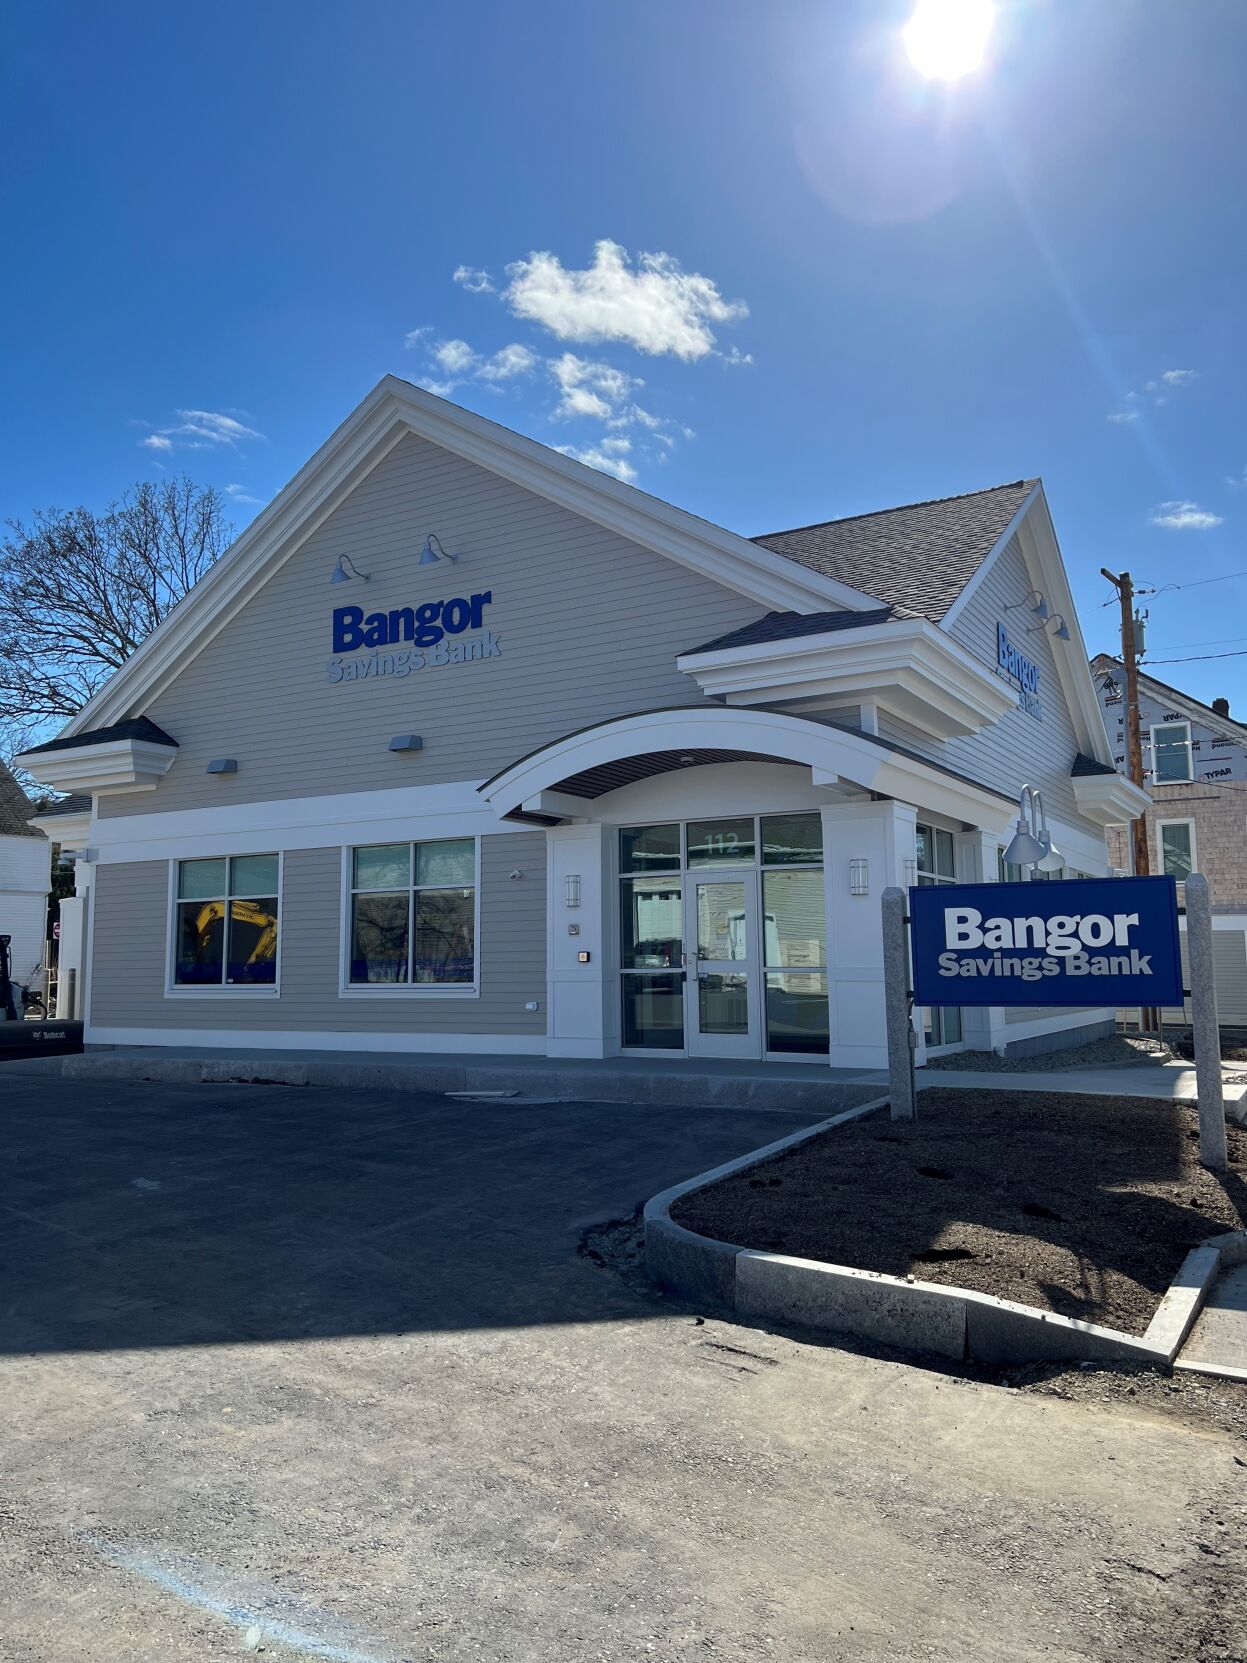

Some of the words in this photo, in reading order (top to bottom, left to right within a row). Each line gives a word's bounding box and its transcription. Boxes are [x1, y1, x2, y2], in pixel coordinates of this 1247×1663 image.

[332, 590, 492, 653] Bangor
[326, 648, 426, 684] Savings
[429, 629, 502, 668] Bank
[997, 621, 1040, 695] Bangor
[1204, 767, 1233, 780] TYPAR
[704, 832, 739, 855] 112
[944, 907, 1139, 957] Bangor
[938, 952, 1060, 981] Savings
[1065, 949, 1153, 976] Bank
